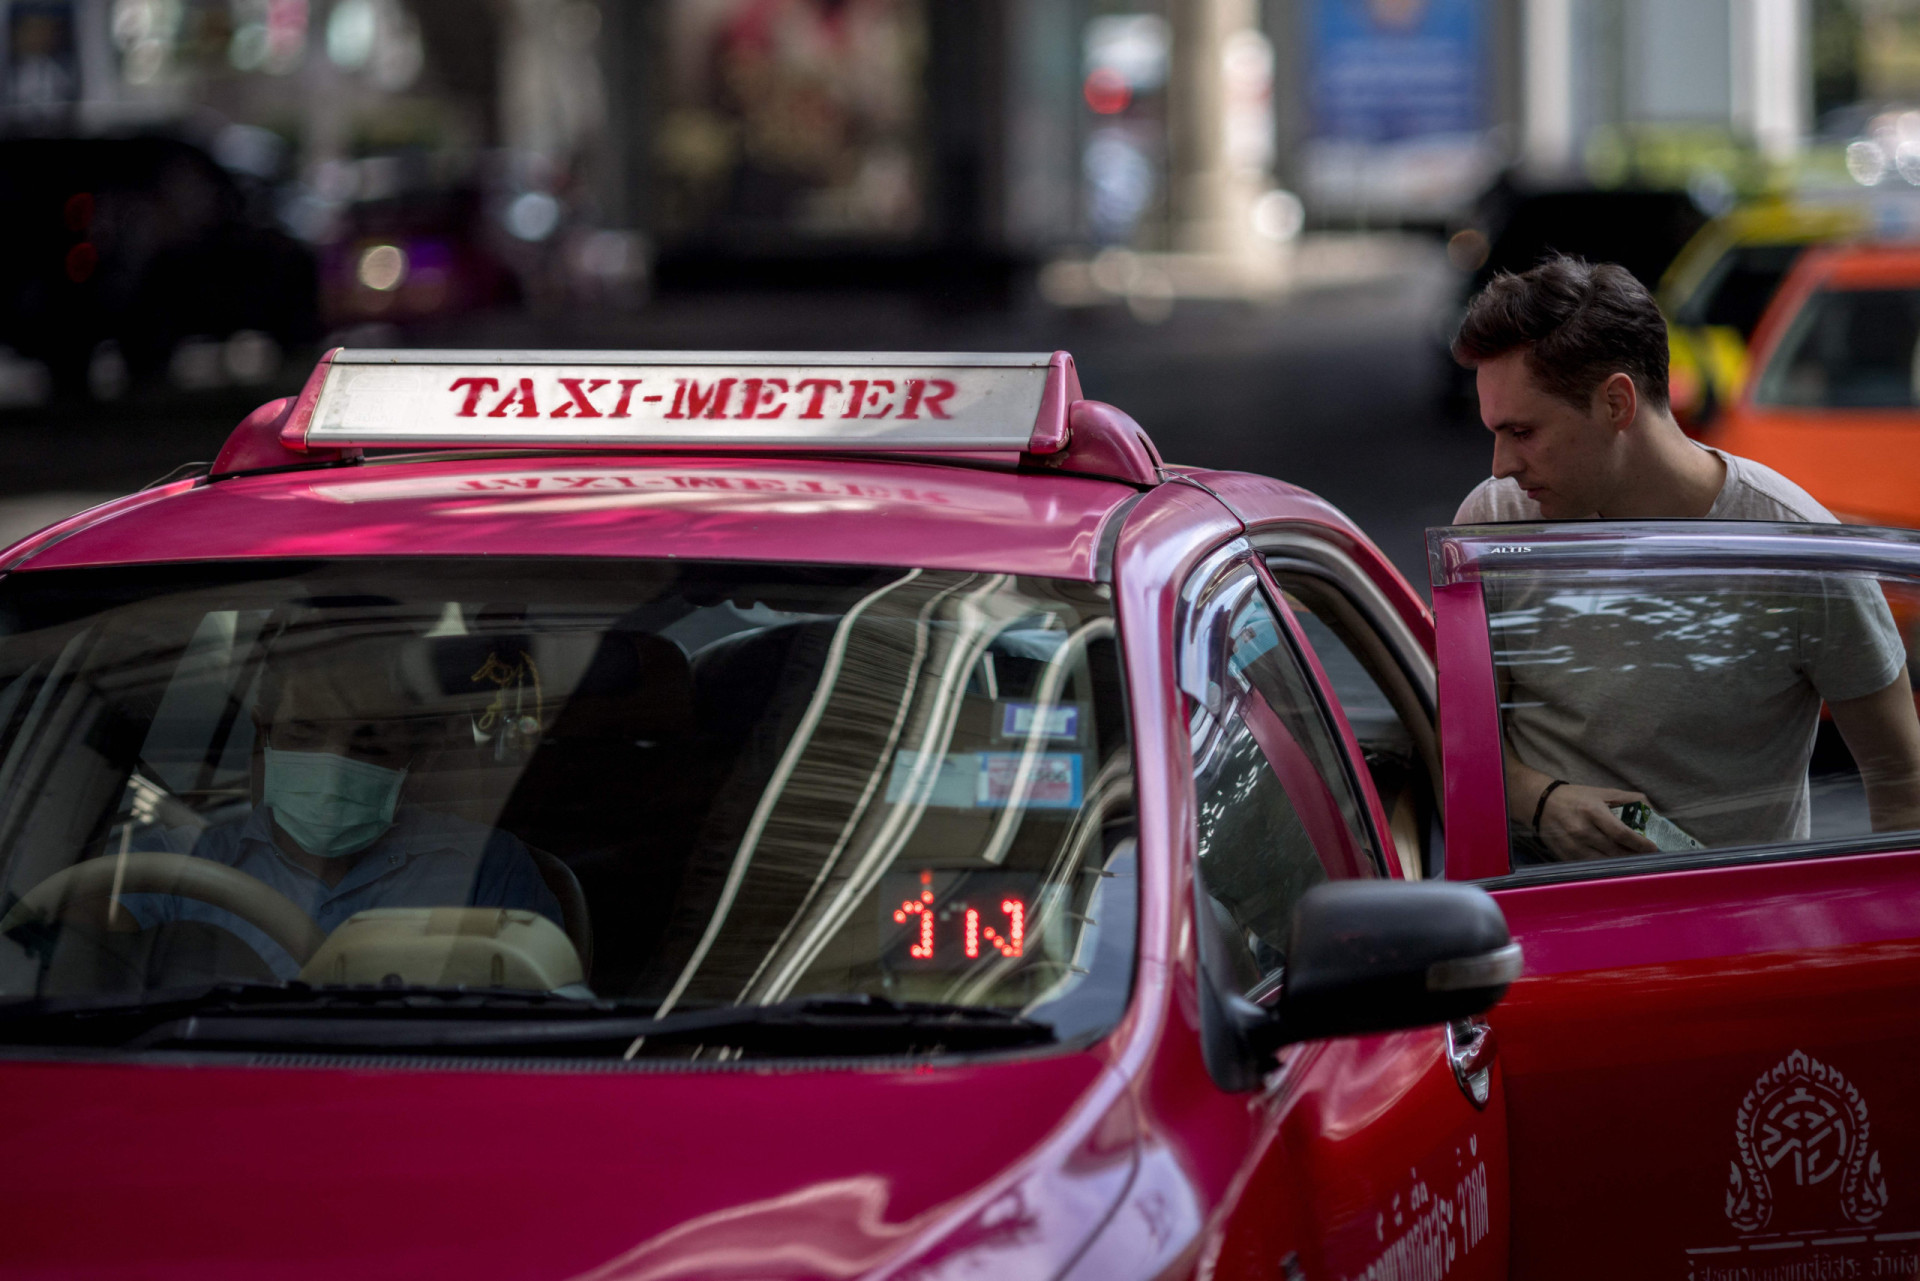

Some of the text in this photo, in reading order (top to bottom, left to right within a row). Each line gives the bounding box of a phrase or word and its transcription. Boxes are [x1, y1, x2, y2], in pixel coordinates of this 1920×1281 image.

[448, 377, 957, 420] TAXI-METER
[1490, 546, 1532, 554] ALTIS
[1457, 1134, 1489, 1255] จำกัด
